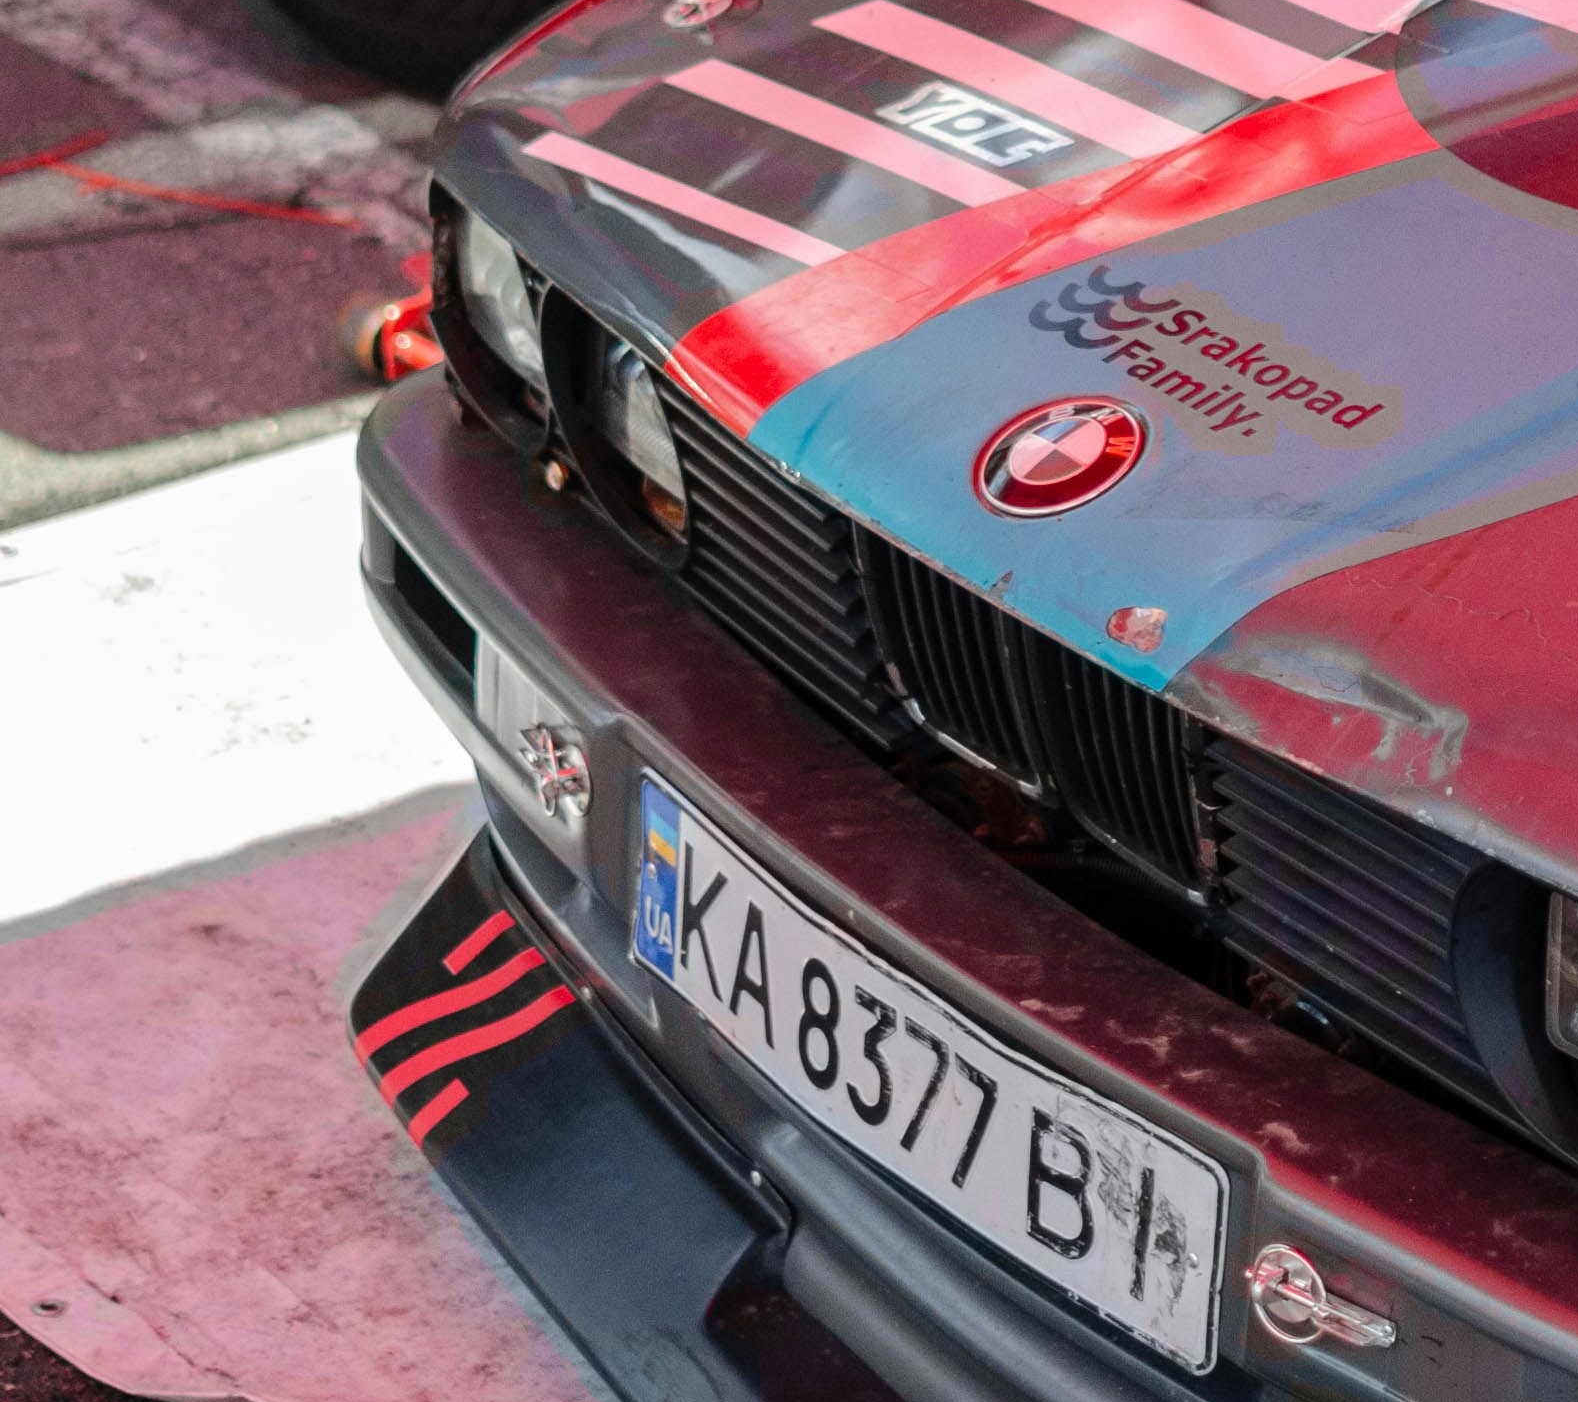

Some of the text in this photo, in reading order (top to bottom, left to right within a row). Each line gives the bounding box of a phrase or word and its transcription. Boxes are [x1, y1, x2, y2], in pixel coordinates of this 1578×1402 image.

[1101, 339, 1257, 440] Family.
[1154, 306, 1386, 431] Srakopad
[1046, 403, 1132, 457] BMW
[643, 896, 675, 956] UA
[679, 840, 776, 1052] KA
[796, 956, 999, 1189] 8377
